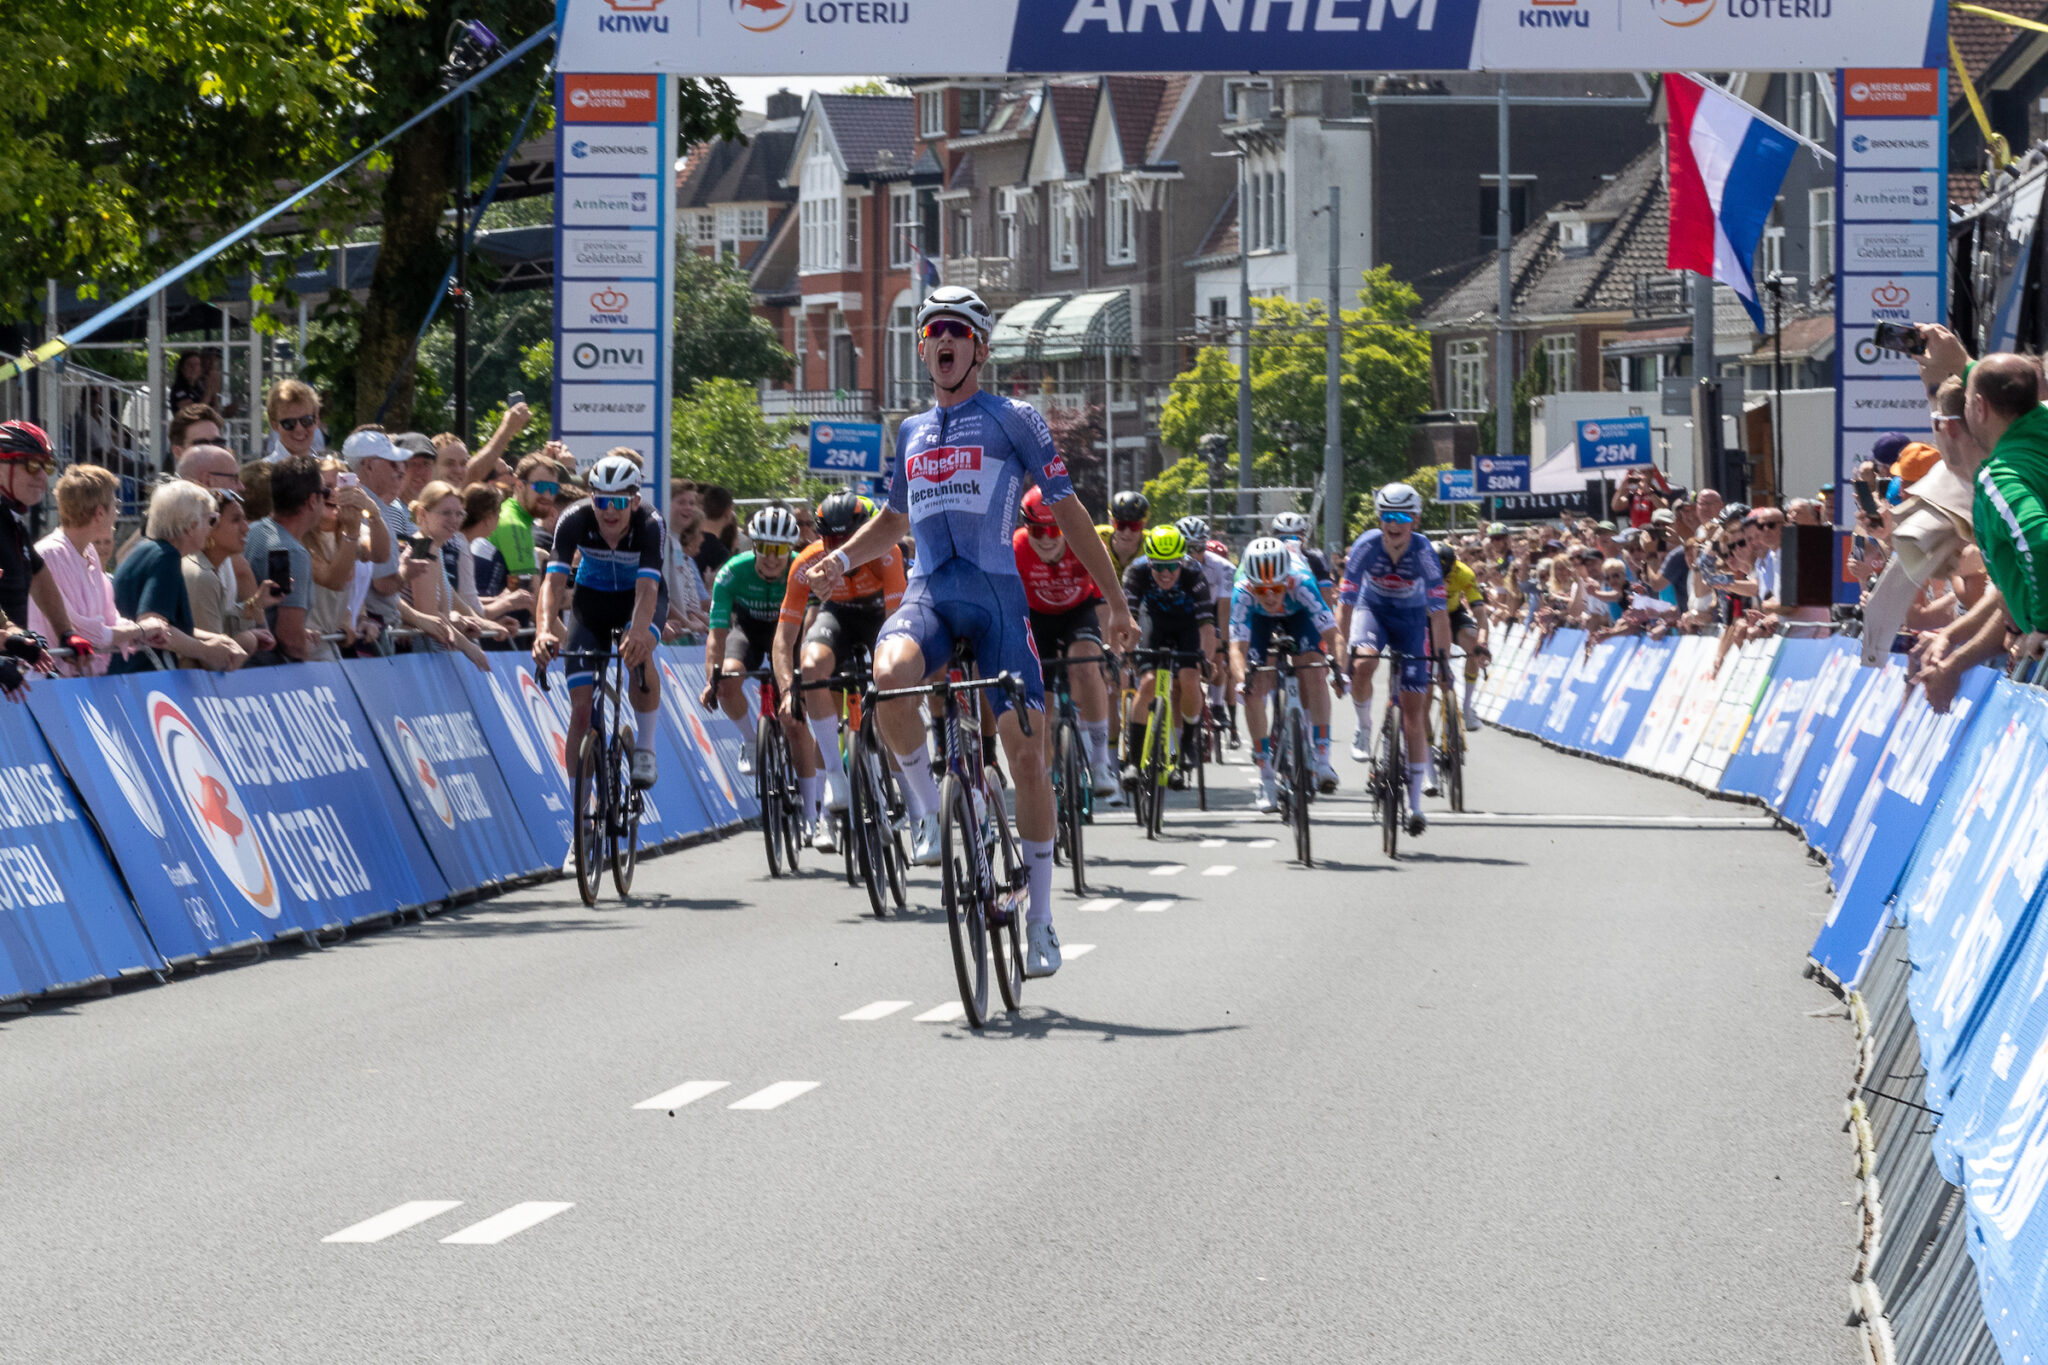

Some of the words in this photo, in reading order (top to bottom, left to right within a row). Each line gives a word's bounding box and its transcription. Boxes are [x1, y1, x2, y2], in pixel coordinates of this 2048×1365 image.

[805, 2, 909, 24] LOTERIJ
[1728, 0, 1831, 18] LOTERIJ
[573, 197, 630, 210] Arnhem
[1854, 192, 1911, 204] Arnhem
[576, 252, 643, 265] Gelderland
[1857, 247, 1924, 259] Gelderland
[824, 448, 868, 468] 25M
[911, 449, 971, 476] Alpecin
[1594, 442, 1638, 463] 25M
[911, 480, 981, 505] deceuninck
[1487, 475, 1522, 490] 50M
[1000, 475, 1019, 546] deceuninck
[1505, 493, 1582, 509] UTILITY
[192, 685, 369, 786] NEDERLANDSE
[254, 804, 371, 902] LOTERIJ
